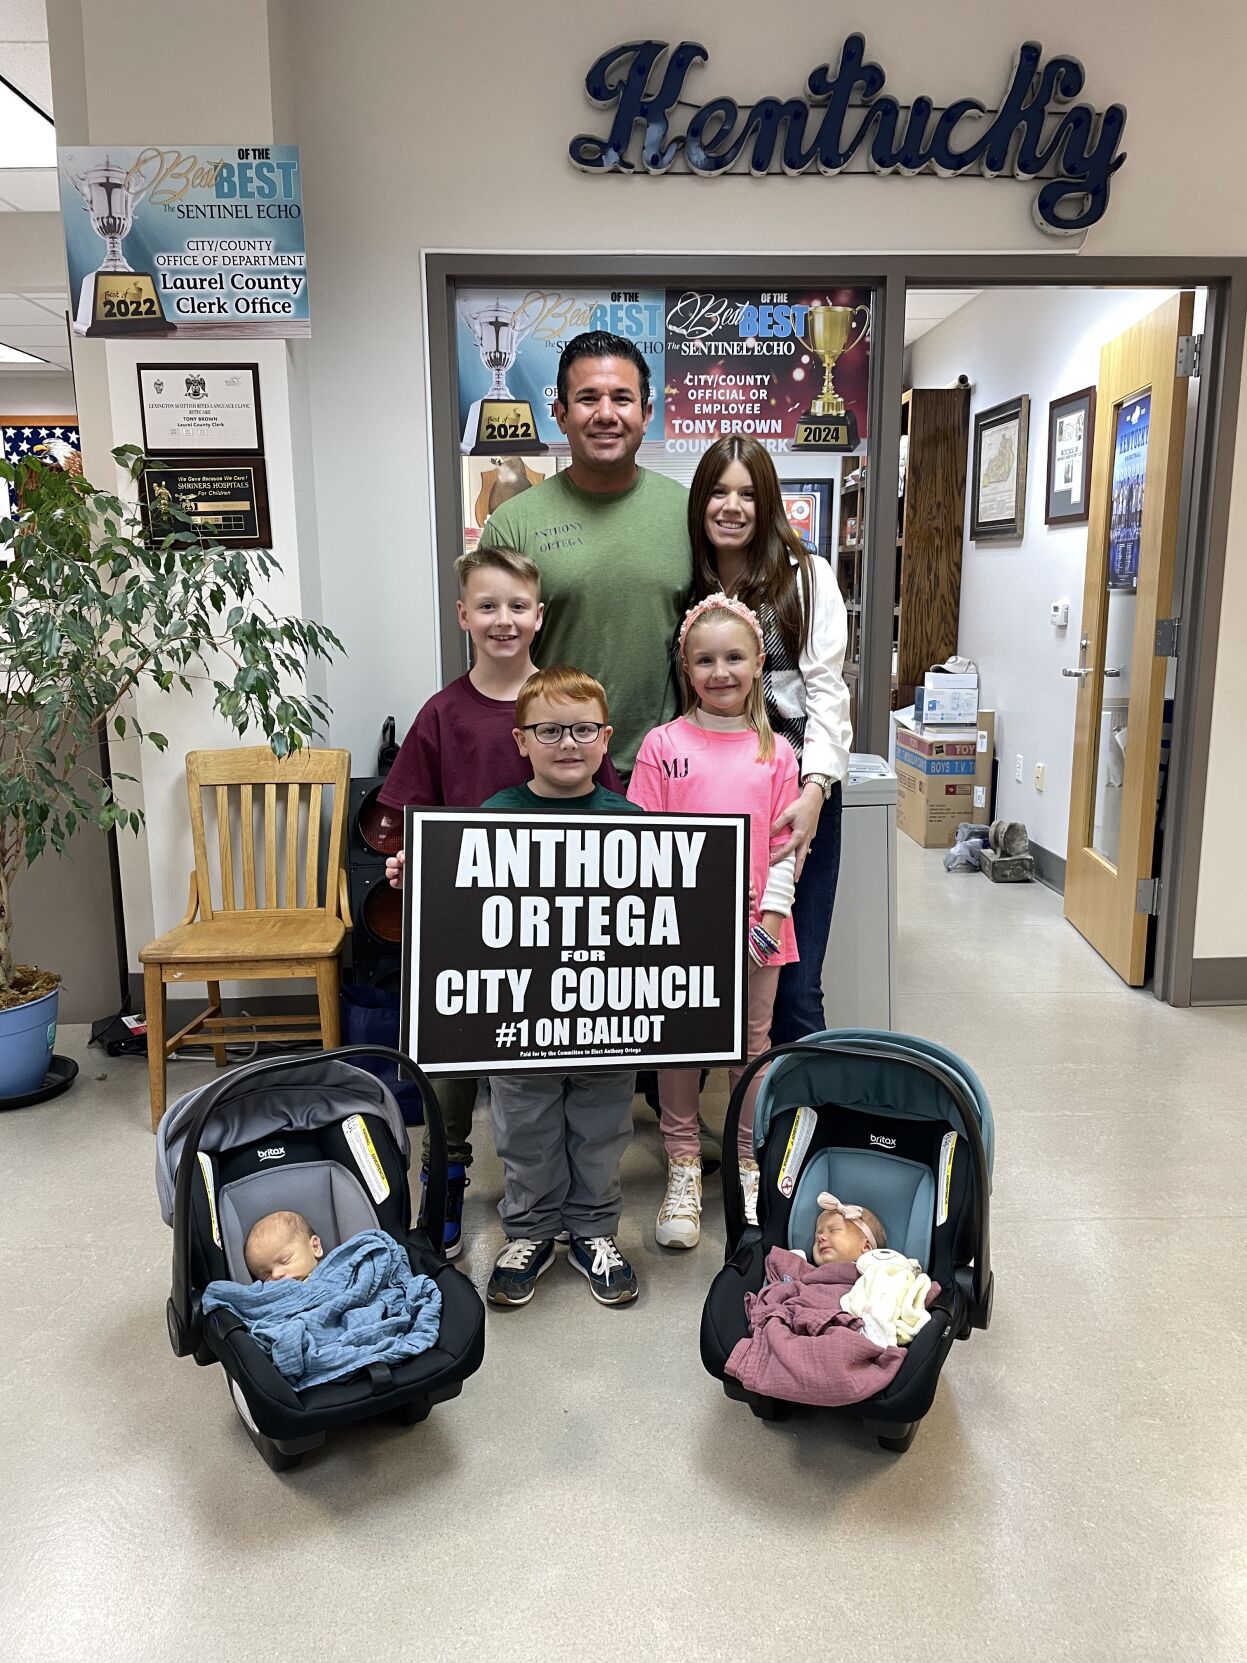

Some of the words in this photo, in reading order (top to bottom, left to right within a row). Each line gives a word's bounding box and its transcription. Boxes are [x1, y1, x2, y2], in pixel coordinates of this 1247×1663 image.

[569, 32, 1127, 236] Kentucky
[238, 149, 250, 160] OF
[252, 148, 270, 160] THE
[124, 147, 225, 205] Best
[215, 161, 297, 200] BEST
[163, 204, 176, 213] The
[177, 204, 254, 220] SENTINEL
[257, 203, 301, 219] ECHO
[186, 240, 273, 252] CITY/COUNTY
[156, 256, 199, 266] OFFICE
[202, 256, 219, 266] OF
[222, 255, 304, 266] DEPARTMENT
[161, 273, 225, 290] Laurel
[230, 274, 303, 295] County
[104, 291, 120, 300] Best
[611, 292, 622, 302] OF
[623, 292, 640, 302] THE
[760, 293, 772, 303] OF
[773, 293, 788, 303] THE
[103, 298, 157, 318] 2022
[176, 297, 229, 314] Clerk
[234, 297, 292, 314] Office
[510, 290, 598, 340] Best
[591, 304, 662, 337] BEST
[665, 291, 750, 340] Best
[739, 305, 809, 337] BEST
[634, 341, 664, 354] CHO
[667, 342, 680, 350] The
[681, 342, 752, 356] SENTINEL
[754, 342, 796, 355] ECHO
[686, 374, 770, 387] CITY/COUNTY
[687, 389, 746, 400] OFFICIAL
[750, 389, 768, 400] OR
[694, 403, 761, 414] EMPLOYEE
[487, 416, 500, 424] Best
[672, 419, 717, 434] TONY
[720, 419, 782, 434] BROWN
[485, 423, 532, 439] 2022
[803, 427, 840, 443] 2024
[665, 438, 712, 453] COUN
[177, 482, 212, 490] SHRINERS
[535, 522, 583, 540] ANTHONY
[540, 537, 583, 553] ORTEGA
[662, 758, 689, 780] MJ
[930, 762, 950, 773] BOYS
[455, 828, 707, 889] ANTHONY
[481, 895, 680, 949] ORTEGA
[561, 950, 606, 962] FOR
[435, 968, 533, 1016] CITY
[550, 965, 721, 1013] COUNCIL
[495, 1019, 529, 1048] #1
[535, 1018, 570, 1047] ON
[576, 1015, 665, 1044] BALLOT
[540, 1050, 547, 1058] by
[870, 1134, 897, 1146] britax
[257, 1146, 286, 1158] britax
